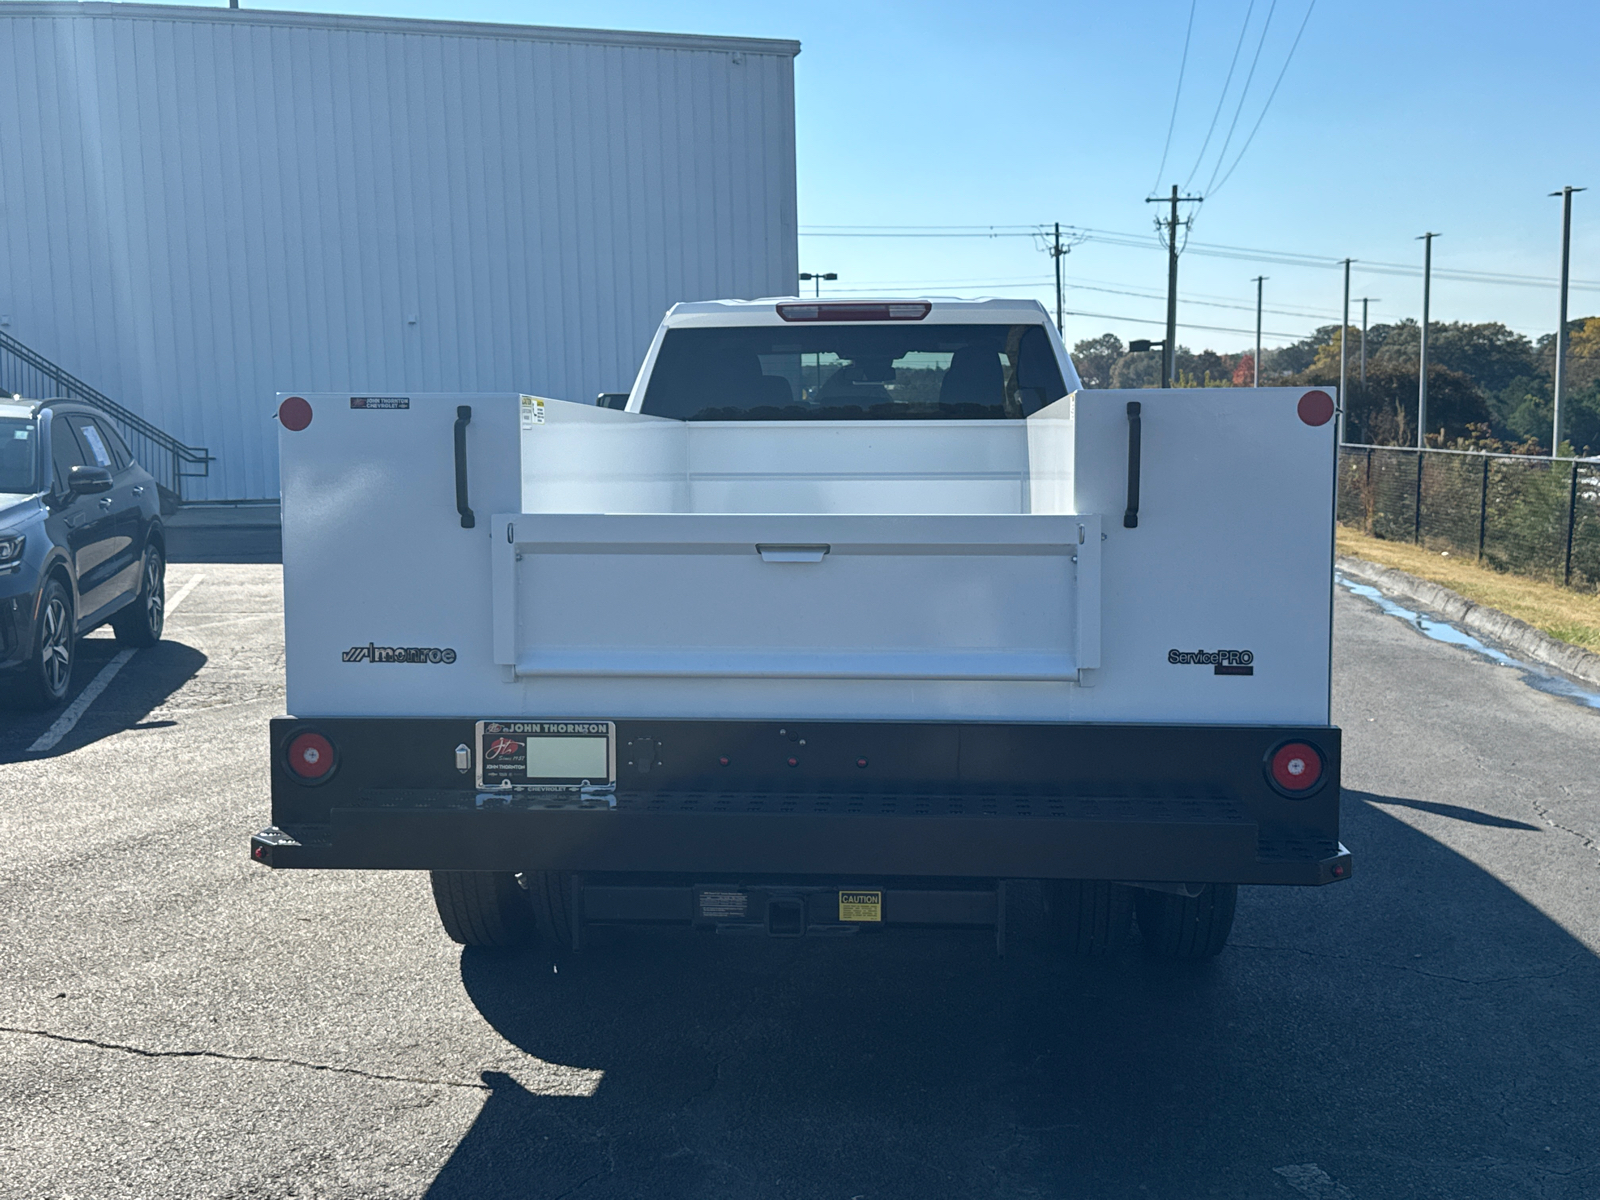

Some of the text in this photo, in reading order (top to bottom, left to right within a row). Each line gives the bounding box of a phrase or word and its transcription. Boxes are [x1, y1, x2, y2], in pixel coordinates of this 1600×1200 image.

[371, 645, 457, 665] monroe
[1168, 648, 1254, 666] ServicePRO
[509, 723, 607, 734] JOHN THORNTON
[842, 895, 878, 904] CAUTION
